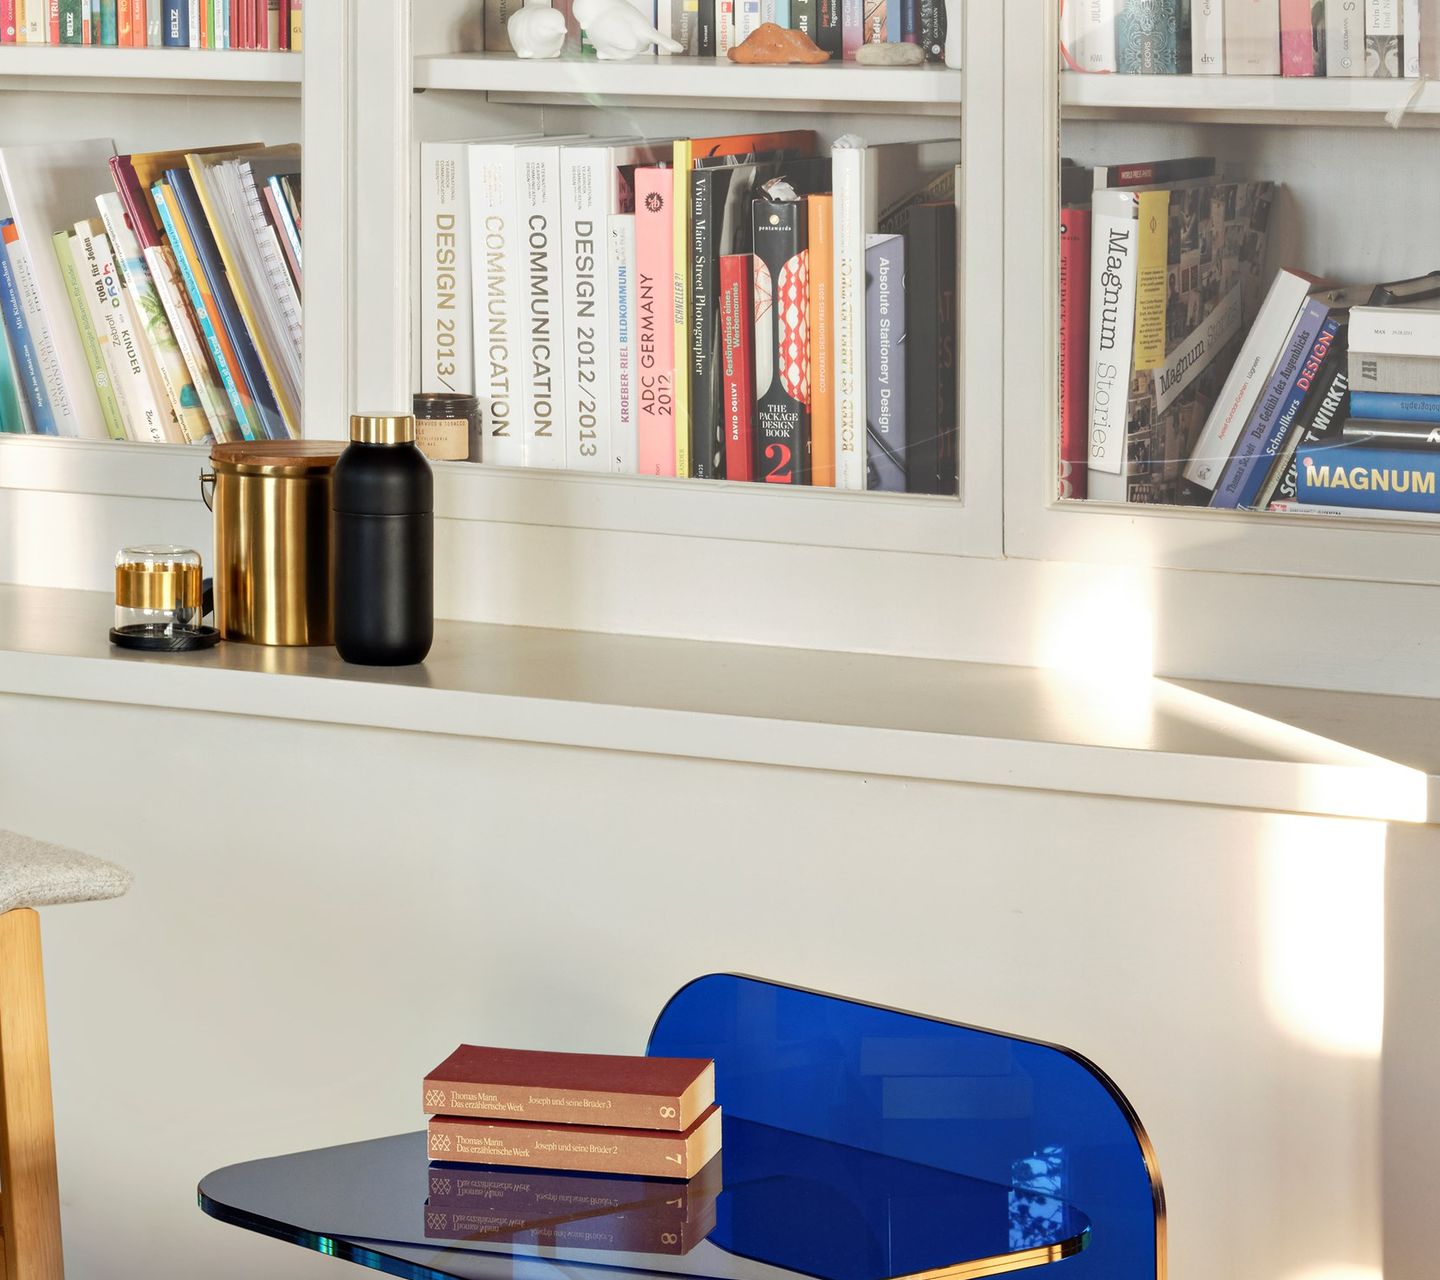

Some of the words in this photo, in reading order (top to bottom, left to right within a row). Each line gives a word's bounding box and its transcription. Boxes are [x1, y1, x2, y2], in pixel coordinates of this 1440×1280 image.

[695, 178, 706, 215] Vivian
[83, 237, 96, 261] Jeden
[694, 219, 705, 251] Maier
[92, 263, 101, 277] für
[436, 214, 456, 311] DESIGN
[575, 221, 595, 317] DESIGN
[693, 255, 704, 294] Street
[95, 280, 107, 303] YOGA
[879, 257, 890, 310] Absolute
[1100, 228, 1129, 350] Magnum
[105, 314, 121, 347] Zebroff
[485, 216, 510, 437] COMMUNICATION
[530, 215, 551, 437] COMMUNICATION
[640, 273, 654, 368] GERMANY
[692, 298, 704, 376] Photographer
[879, 319, 891, 384] Stationery
[577, 327, 596, 456] 2012/2013
[642, 375, 655, 416] ADC
[657, 374, 671, 415] 2012
[1252, 425, 1266, 439] Das
[1260, 395, 1280, 423] Gefühl
[1276, 377, 1286, 397] des
[1283, 330, 1310, 379] Augenblicks
[1266, 399, 1300, 456] Schnellkurs
[1297, 331, 1333, 391] DESIGN
[760, 412, 799, 421] PACKAGE
[768, 404, 786, 412] THE
[879, 388, 890, 433] Design
[1091, 361, 1116, 458] Stories
[766, 429, 790, 438] BOOK
[764, 443, 792, 483] 2
[1306, 465, 1435, 494] MAGNUM
[451, 1091, 477, 1102] Thomas
[478, 1094, 497, 1102] Mann
[451, 1101, 464, 1109] Das
[506, 1103, 524, 1111] Werk
[529, 1096, 550, 1106] Joseph
[552, 1098, 565, 1106] und
[566, 1099, 583, 1107] seine
[583, 1100, 606, 1108] Brüder
[660, 1107, 676, 1118] 8
[457, 1136, 482, 1146] Thomas
[484, 1138, 503, 1146] Mann
[457, 1145, 469, 1153] Das
[512, 1148, 530, 1157] Werk
[534, 1141, 557, 1151] Joseph
[558, 1143, 571, 1151] und
[572, 1144, 588, 1152] seine
[589, 1145, 611, 1154] Brüder
[613, 1146, 618, 1154] 2
